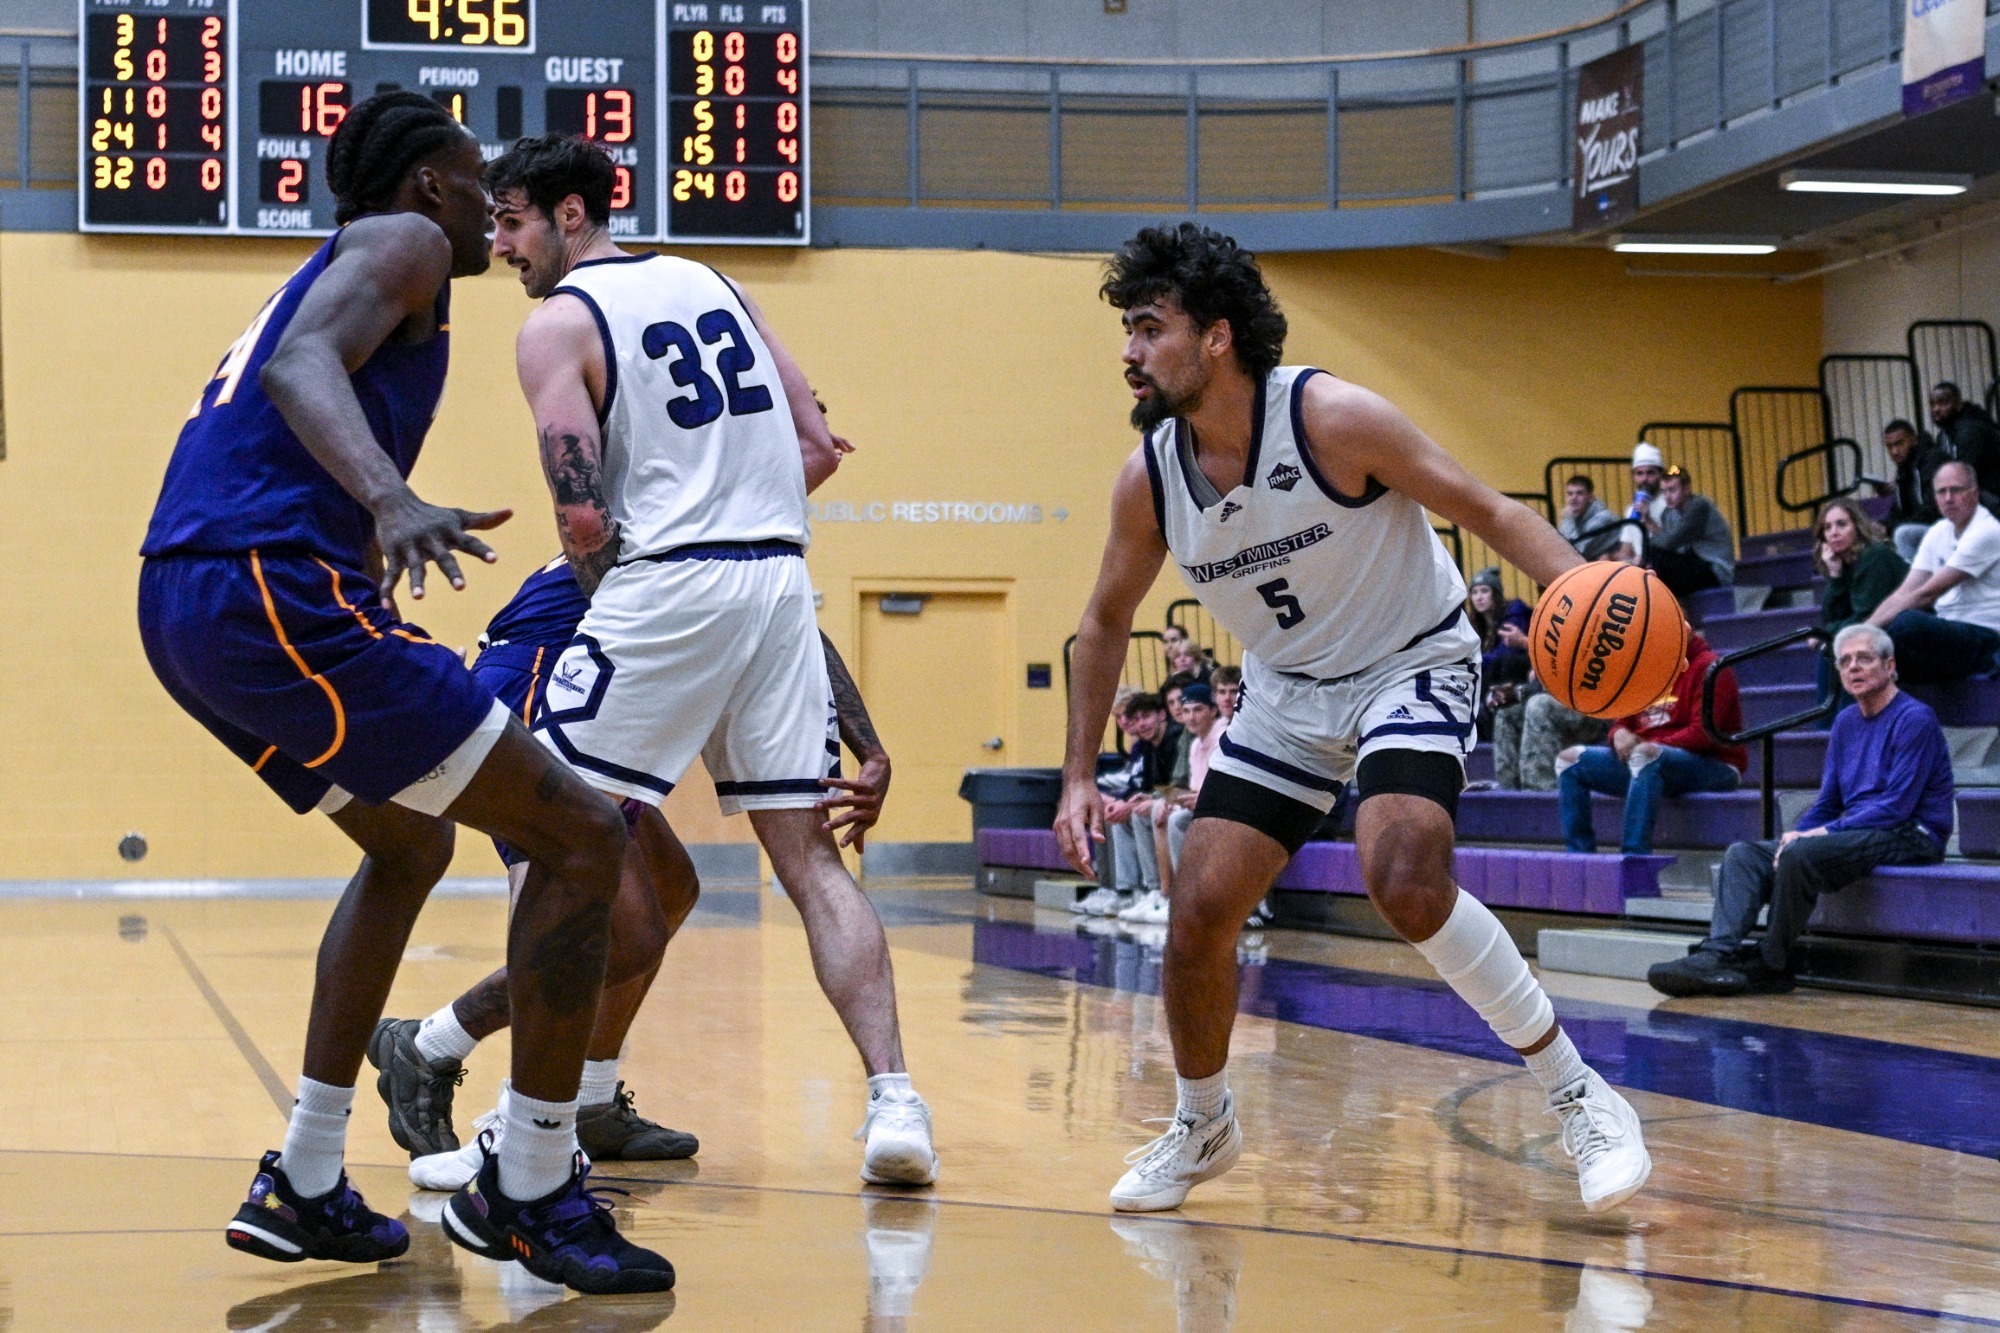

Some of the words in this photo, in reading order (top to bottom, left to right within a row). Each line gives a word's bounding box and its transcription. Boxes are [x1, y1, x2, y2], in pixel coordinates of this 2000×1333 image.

[408, 0, 524, 45] 4:56
[674, 5, 708, 21] PLYR
[720, 6, 744, 22] FLS
[762, 7, 786, 23] PTS
[117, 14, 133, 46] 3
[158, 18, 166, 44] 1
[202, 17, 220, 48] 2
[693, 31, 713, 61] 0
[725, 32, 744, 62] 0
[777, 33, 796, 63] 0
[114, 49, 133, 80] 5
[147, 50, 166, 81] 0
[204, 51, 220, 82] 3
[276, 50, 346, 76] HOME
[419, 67, 479, 86] PERIOD
[545, 57, 623, 83] GUEST
[696, 65, 713, 95] 3
[725, 66, 744, 95] 0
[777, 69, 796, 93] 4
[104, 88, 133, 114] 11
[147, 86, 166, 118] 0
[202, 88, 220, 119] 0
[302, 83, 346, 136] 16
[587, 91, 631, 141] 13
[694, 101, 713, 131] 5
[736, 105, 744, 129] 1
[778, 102, 797, 132] 0
[92, 119, 133, 151] 24
[158, 124, 166, 149] 1
[202, 125, 220, 151] 4
[257, 140, 311, 158] FOULS
[684, 134, 714, 165] 15
[737, 138, 745, 162] 1
[778, 139, 797, 163] 4
[95, 156, 133, 189] 32
[147, 158, 166, 189] 0
[202, 159, 220, 190] 0
[1578, 123, 1639, 198] YOURS
[278, 161, 302, 202] 2
[674, 170, 714, 201] 24
[726, 171, 745, 201] 0
[778, 172, 797, 202] 0
[257, 210, 311, 228] SCORE
[609, 216, 639, 234] ORE
[642, 308, 773, 429] 32
[1269, 468, 1300, 489] RMAC
[892, 503, 1043, 523] RESTROOMS
[1188, 523, 1331, 583] WESTMINSTER
[1231, 555, 1291, 579] GRIFFINS
[1256, 577, 1306, 630] 5
[1580, 593, 1638, 691] Wilson
